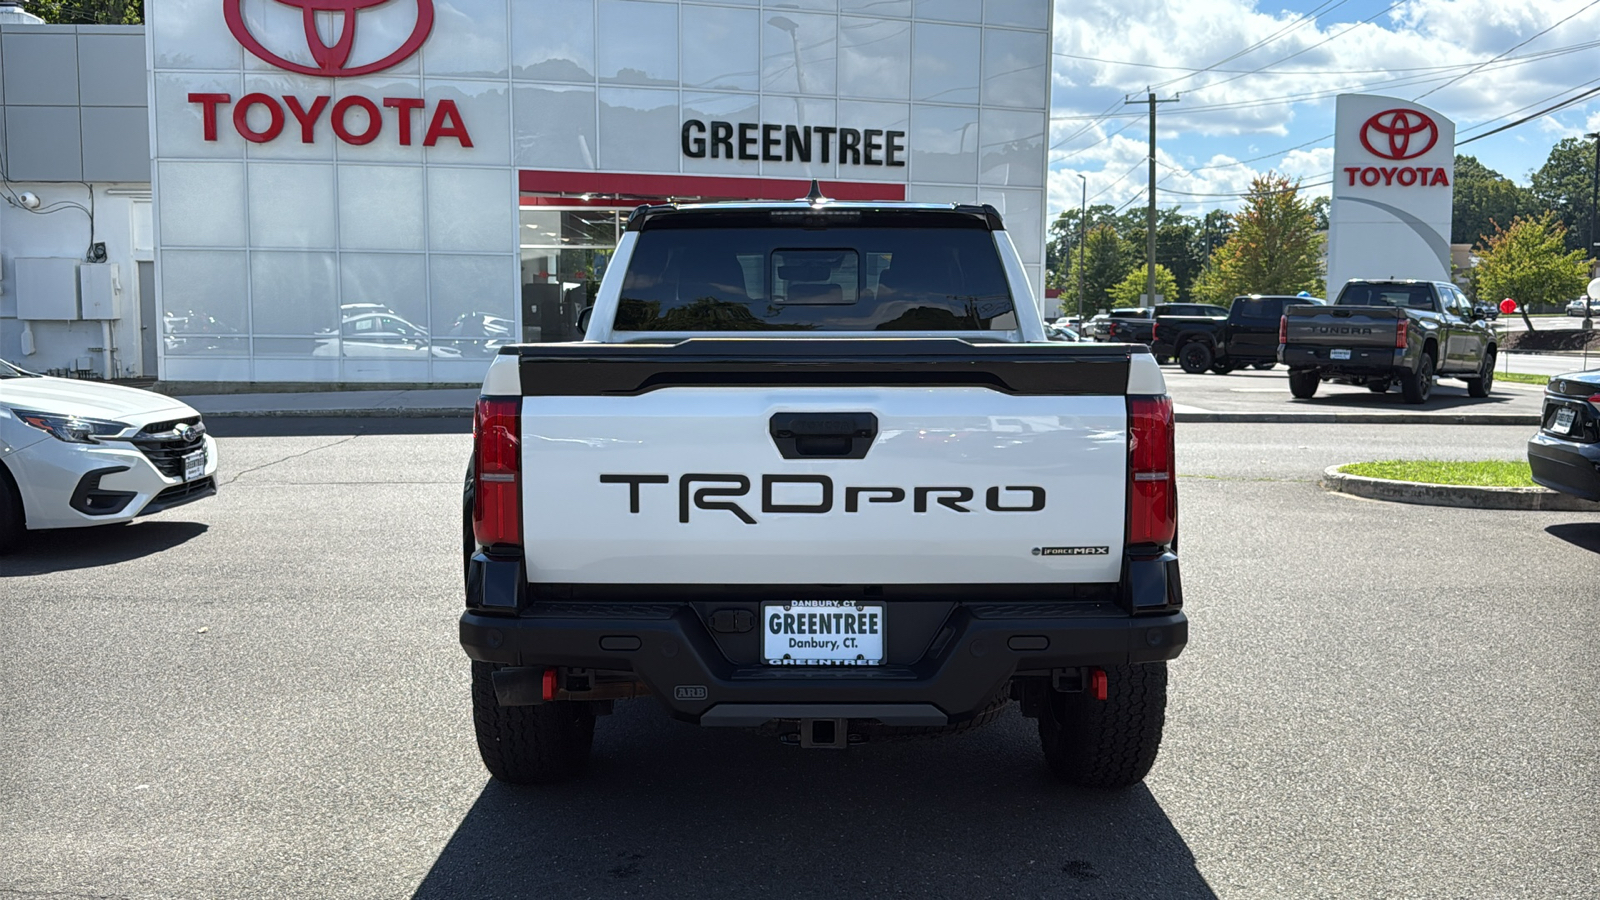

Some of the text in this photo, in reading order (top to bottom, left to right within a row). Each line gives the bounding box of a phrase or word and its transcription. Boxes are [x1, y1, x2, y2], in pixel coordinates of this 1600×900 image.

[188, 93, 474, 148] TOYOTA
[681, 119, 905, 167] GREENTREE
[1343, 166, 1450, 187] TOYOTA
[1310, 327, 1372, 335] TUNDRA
[599, 473, 1047, 525] TRD PRO
[791, 600, 840, 608] DANBURY,
[769, 613, 878, 635] GREENTREE
[789, 637, 858, 652] Danbury, CT.
[677, 688, 705, 698] ARB
